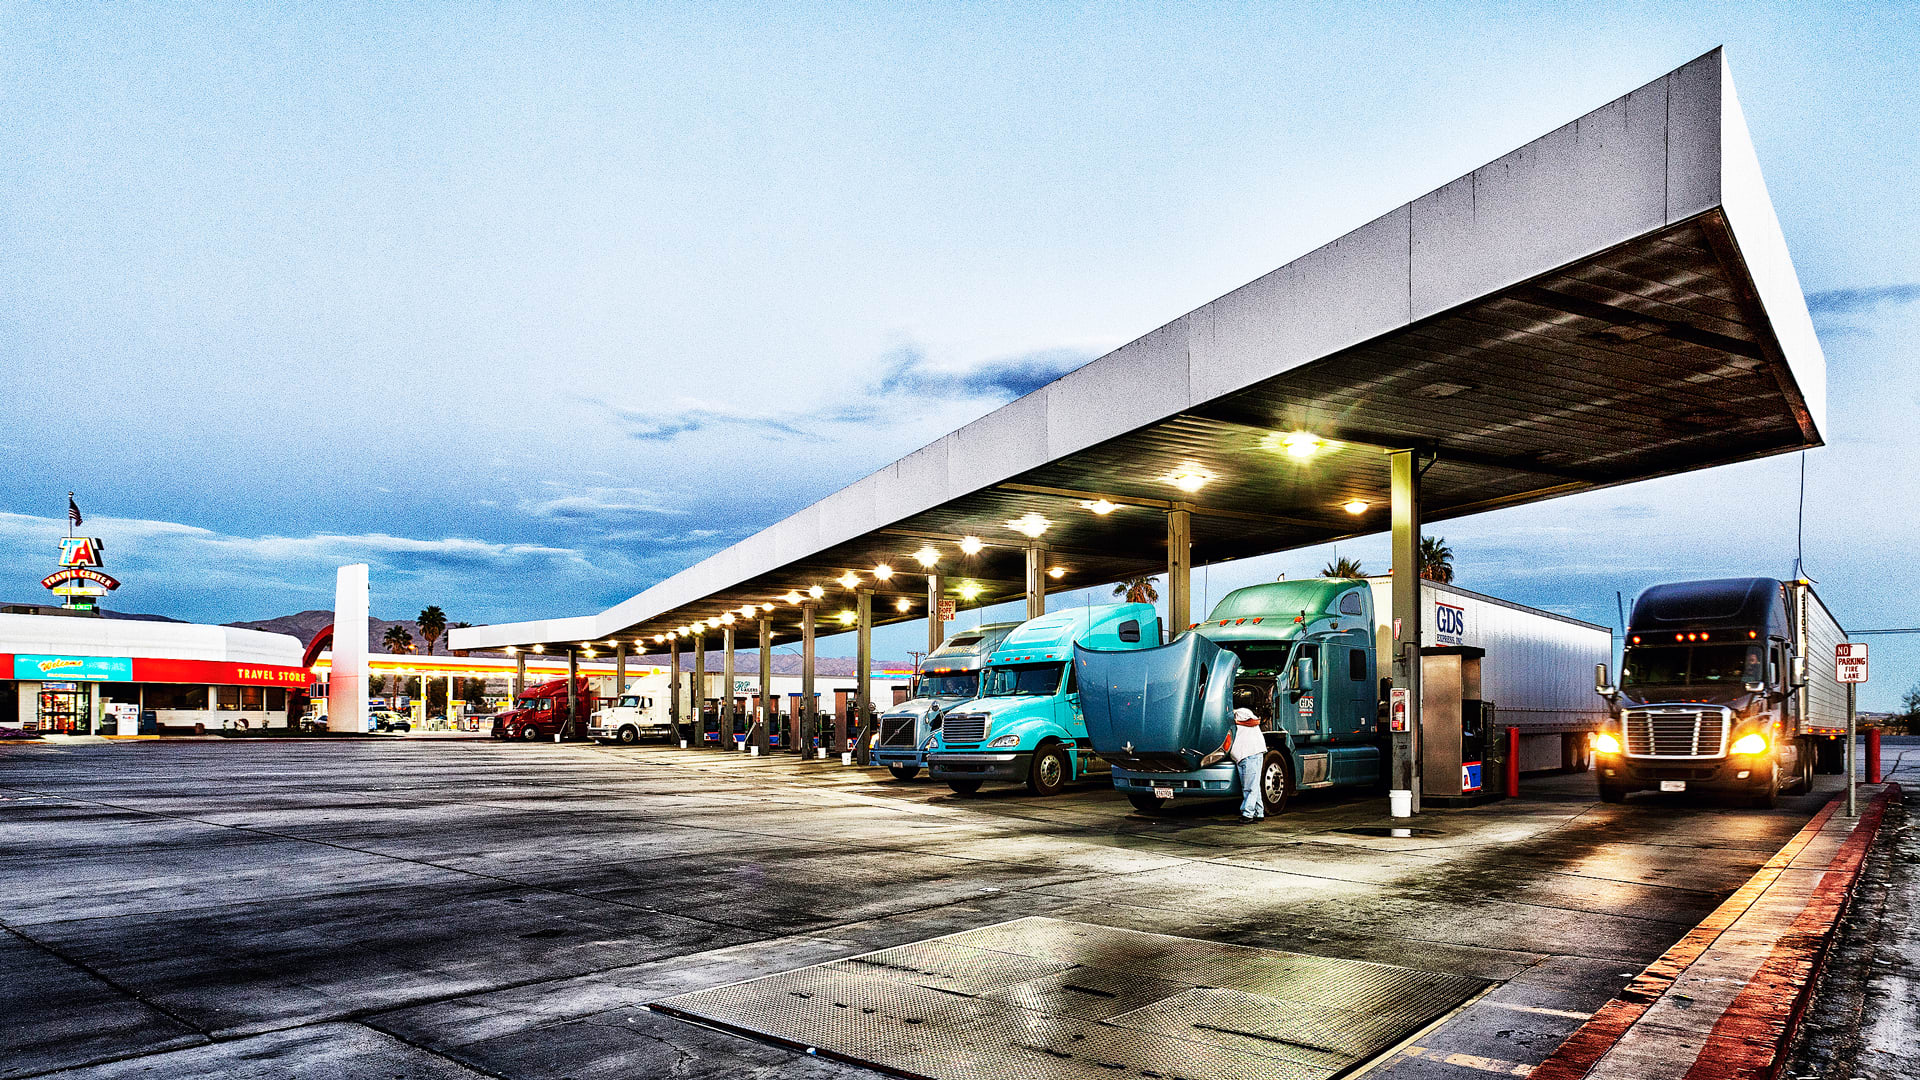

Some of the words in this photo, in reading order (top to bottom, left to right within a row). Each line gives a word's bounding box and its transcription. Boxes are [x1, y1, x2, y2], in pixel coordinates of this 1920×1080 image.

[60, 537, 96, 567] TA
[79, 570, 112, 587] CENTER
[1437, 605, 1463, 636] GDS
[1837, 646, 1849, 655] NO
[38, 658, 83, 672] Welcome
[1838, 657, 1866, 665] PARKING
[237, 668, 274, 680] TRAVEL
[278, 671, 306, 682] STORE
[1299, 697, 1314, 708] GDS
